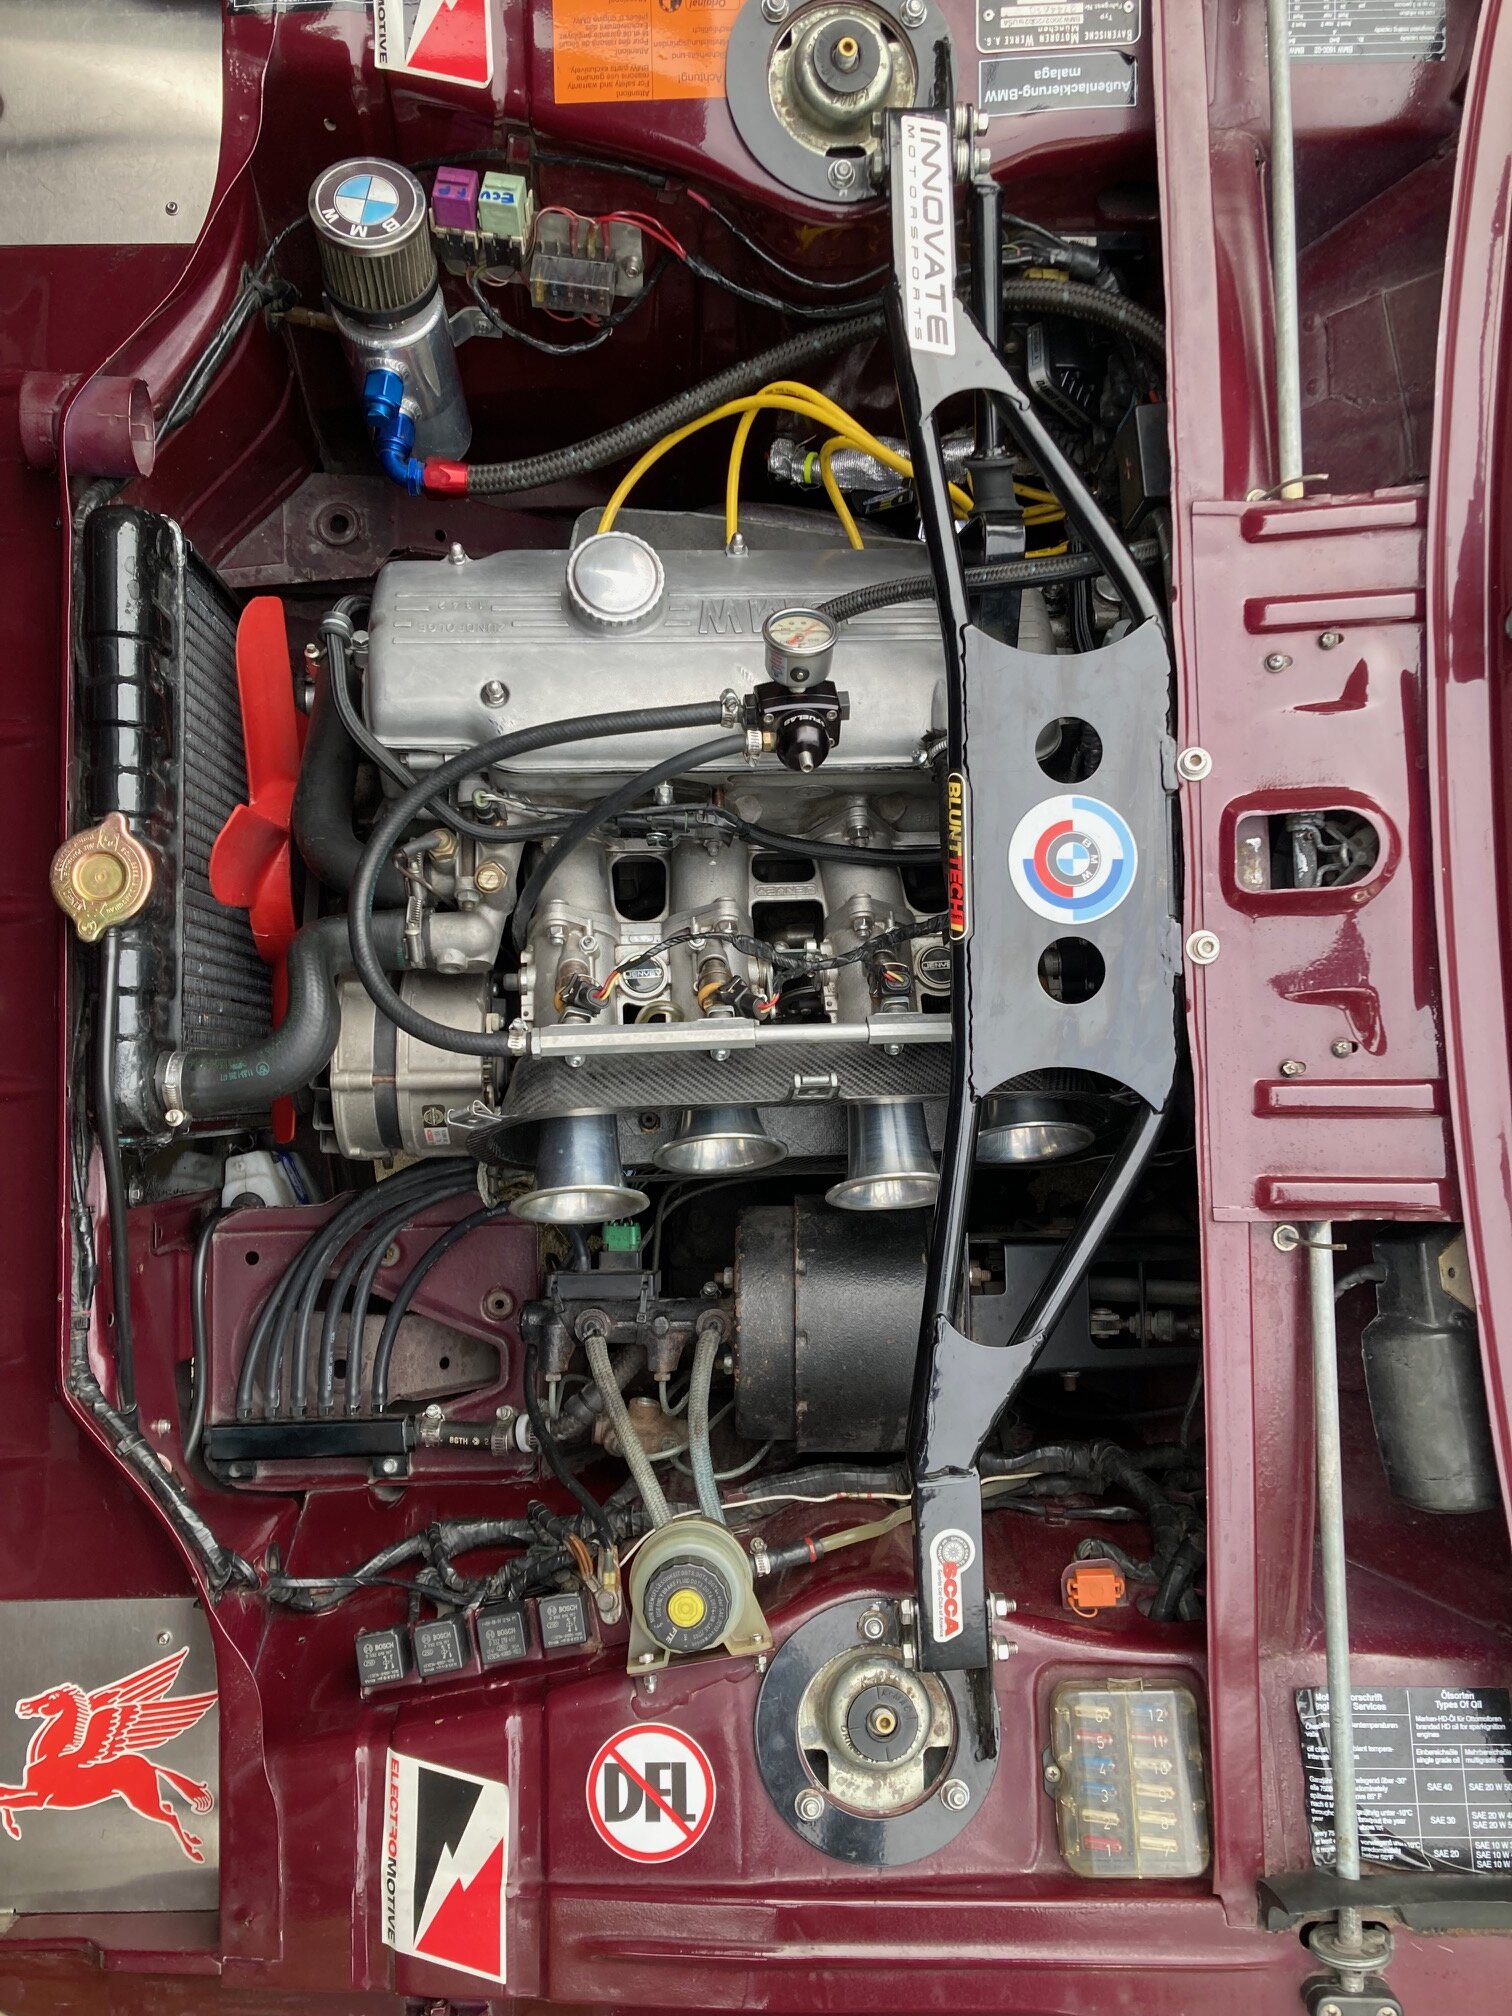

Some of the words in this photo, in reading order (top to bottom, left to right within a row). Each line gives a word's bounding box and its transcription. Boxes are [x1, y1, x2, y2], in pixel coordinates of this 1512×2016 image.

[1099, 13, 1113, 22] Typ
[1037, 24, 1080, 33] München
[1038, 32, 1080, 45] MOTOREN
[1084, 28, 1133, 42] BAYERISCHE
[1004, 34, 1035, 48] WERKE
[677, 72, 722, 84] Achtung!
[1034, 67, 1081, 80] malaga
[616, 90, 650, 98] Attention!
[984, 81, 1131, 103] Außenlackierung-BMW
[322, 208, 401, 239] BMW
[906, 123, 923, 331] MOTORSPORTS
[919, 126, 949, 345] INNOVATE
[1082, 838, 1100, 881] BMW
[922, 961, 951, 970] JENVE
[942, 1561, 959, 1637] SCCA
[558, 1604, 578, 1613] BOSCH
[432, 1631, 452, 1640] BOSCH
[496, 1627, 516, 1637] BOSCH
[665, 1626, 678, 1644] FTE
[374, 1642, 395, 1650] BOSCH
[1314, 1692, 1330, 1701] Mot
[1350, 1692, 1383, 1702] orschrift
[1440, 1689, 1475, 1700] Ölsorten
[1353, 1701, 1387, 1711] Services
[1434, 1700, 1458, 1710] Types
[1458, 1700, 1470, 1709] Of
[1470, 1700, 1483, 1709] Oil
[1148, 1709, 1164, 1722] 12
[1096, 1735, 1105, 1750] 5
[1152, 1736, 1164, 1749] 11
[1416, 1757, 1434, 1765] single
[1099, 1763, 1107, 1776] 4
[603, 1761, 697, 1823] DFL
[1426, 1782, 1443, 1792] SAE
[1442, 1782, 1454, 1792] 40
[1468, 1782, 1484, 1792] SAE
[1484, 1782, 1494, 1791] 20
[1494, 1783, 1503, 1791] W
[1101, 1789, 1109, 1803] 3
[1430, 1816, 1446, 1825] SAE
[1446, 1816, 1456, 1825] 30
[1471, 1811, 1487, 1820] SAE
[1487, 1811, 1497, 1820] 20
[1497, 1811, 1506, 1819] W
[1103, 1817, 1111, 1830] 2
[1393, 1818, 1406, 1826] year
[1472, 1821, 1488, 1830] SAE
[1488, 1821, 1498, 1829] 20
[1498, 1821, 1507, 1829] W
[386, 1757, 399, 1944] ELECTROMOTIVE
[1105, 1843, 1111, 1857] 1
[1475, 1841, 1490, 1850] SAE
[1491, 1841, 1500, 1850] 10
[1500, 1841, 1509, 1850] W
[1433, 1849, 1450, 1858] SAE
[1450, 1849, 1460, 1858] 20
[1475, 1850, 1492, 1859] SAE
[1492, 1850, 1501, 1859] 10
[1501, 1850, 1510, 1859] W
[1476, 1860, 1492, 1869] SAE
[1493, 1860, 1502, 1869] 10
[1501, 1860, 1511, 1869] W
